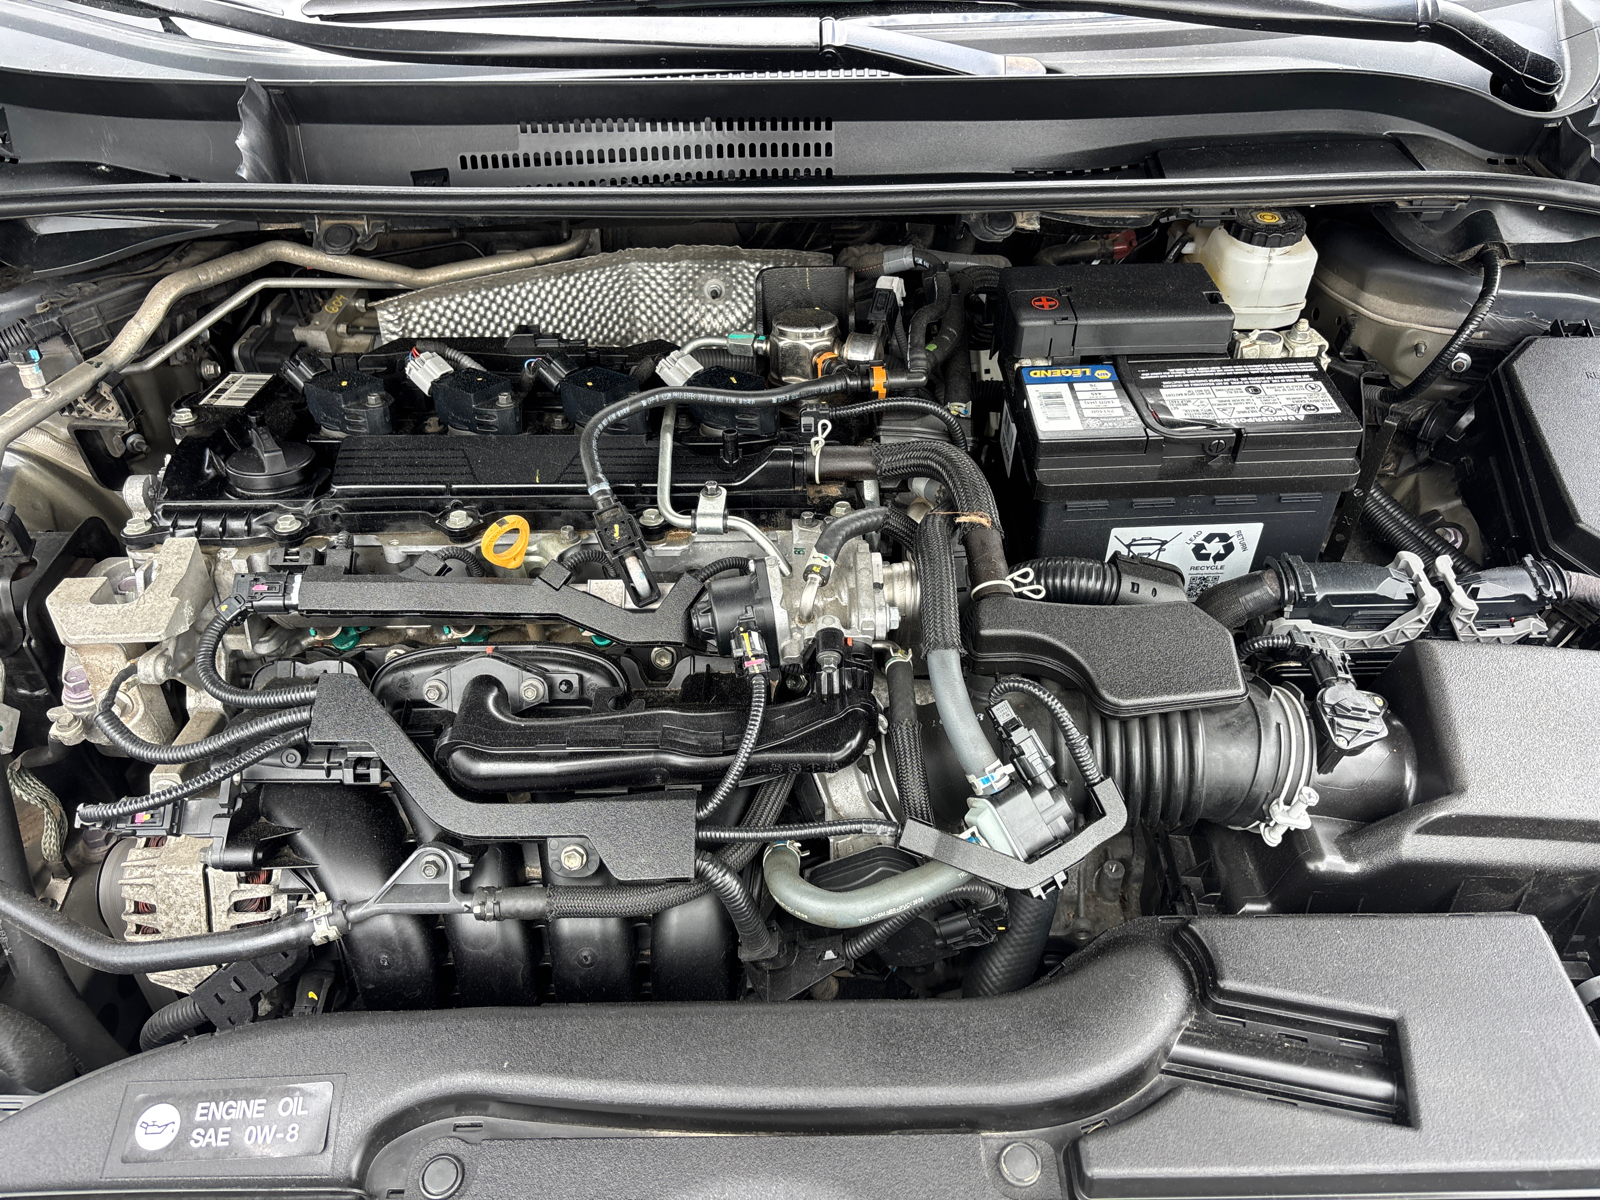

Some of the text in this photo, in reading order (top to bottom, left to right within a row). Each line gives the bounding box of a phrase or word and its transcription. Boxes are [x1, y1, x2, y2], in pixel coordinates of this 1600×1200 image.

[325, 294, 348, 314] 604
[1029, 368, 1090, 378] LEGEND
[1215, 415, 1296, 424] DANGER/POISON
[1185, 530, 1203, 545] LEAD
[1235, 530, 1248, 552] RETURN
[195, 1096, 309, 1121] ENGINE OIL
[190, 1123, 299, 1148] SAE 0W-8
